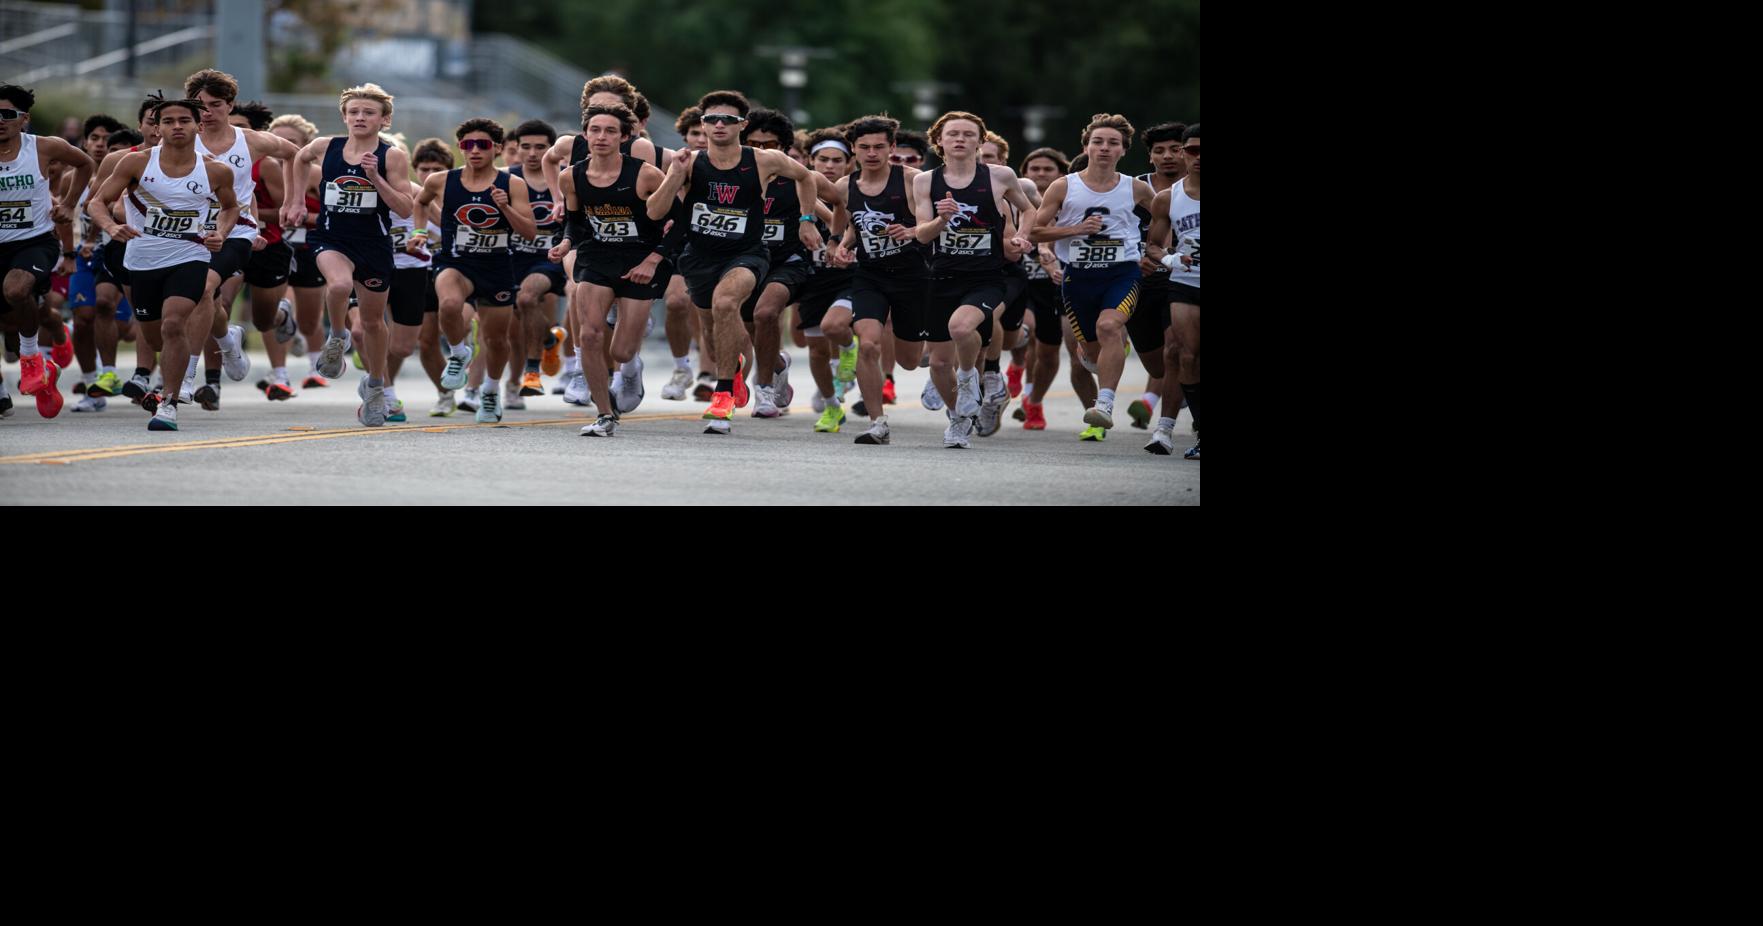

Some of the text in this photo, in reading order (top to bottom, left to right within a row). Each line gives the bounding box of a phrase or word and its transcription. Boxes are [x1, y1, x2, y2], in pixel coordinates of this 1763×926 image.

[337, 191, 364, 207] 311
[151, 214, 193, 232] 1019
[697, 213, 740, 232] 646
[465, 232, 498, 248] 310
[945, 232, 984, 249] 567
[1076, 246, 1117, 262] 388
